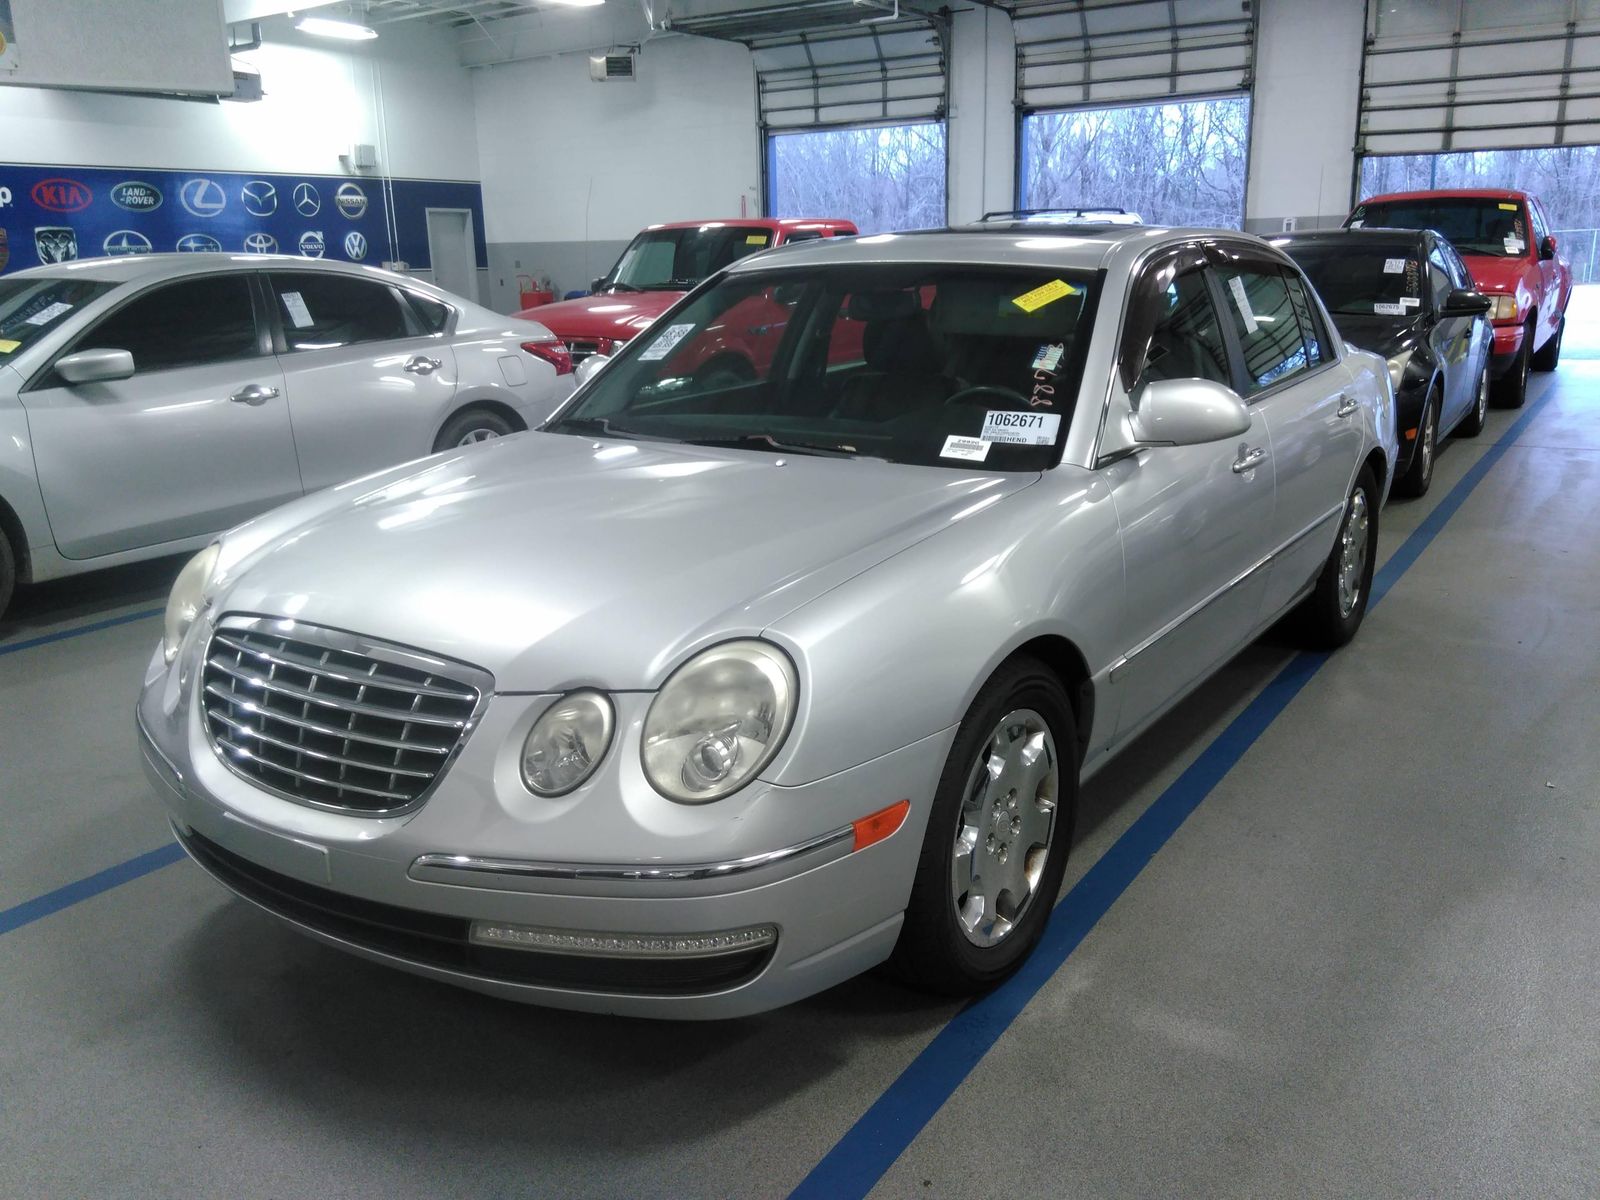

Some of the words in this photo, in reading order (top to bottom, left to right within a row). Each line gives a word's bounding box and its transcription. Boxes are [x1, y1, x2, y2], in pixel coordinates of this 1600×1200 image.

[41, 186, 85, 205] KIA
[122, 187, 146, 197] LAND
[126, 196, 155, 205] ROVER
[337, 198, 366, 206] NISSAN
[988, 413, 1044, 429] 1062671
